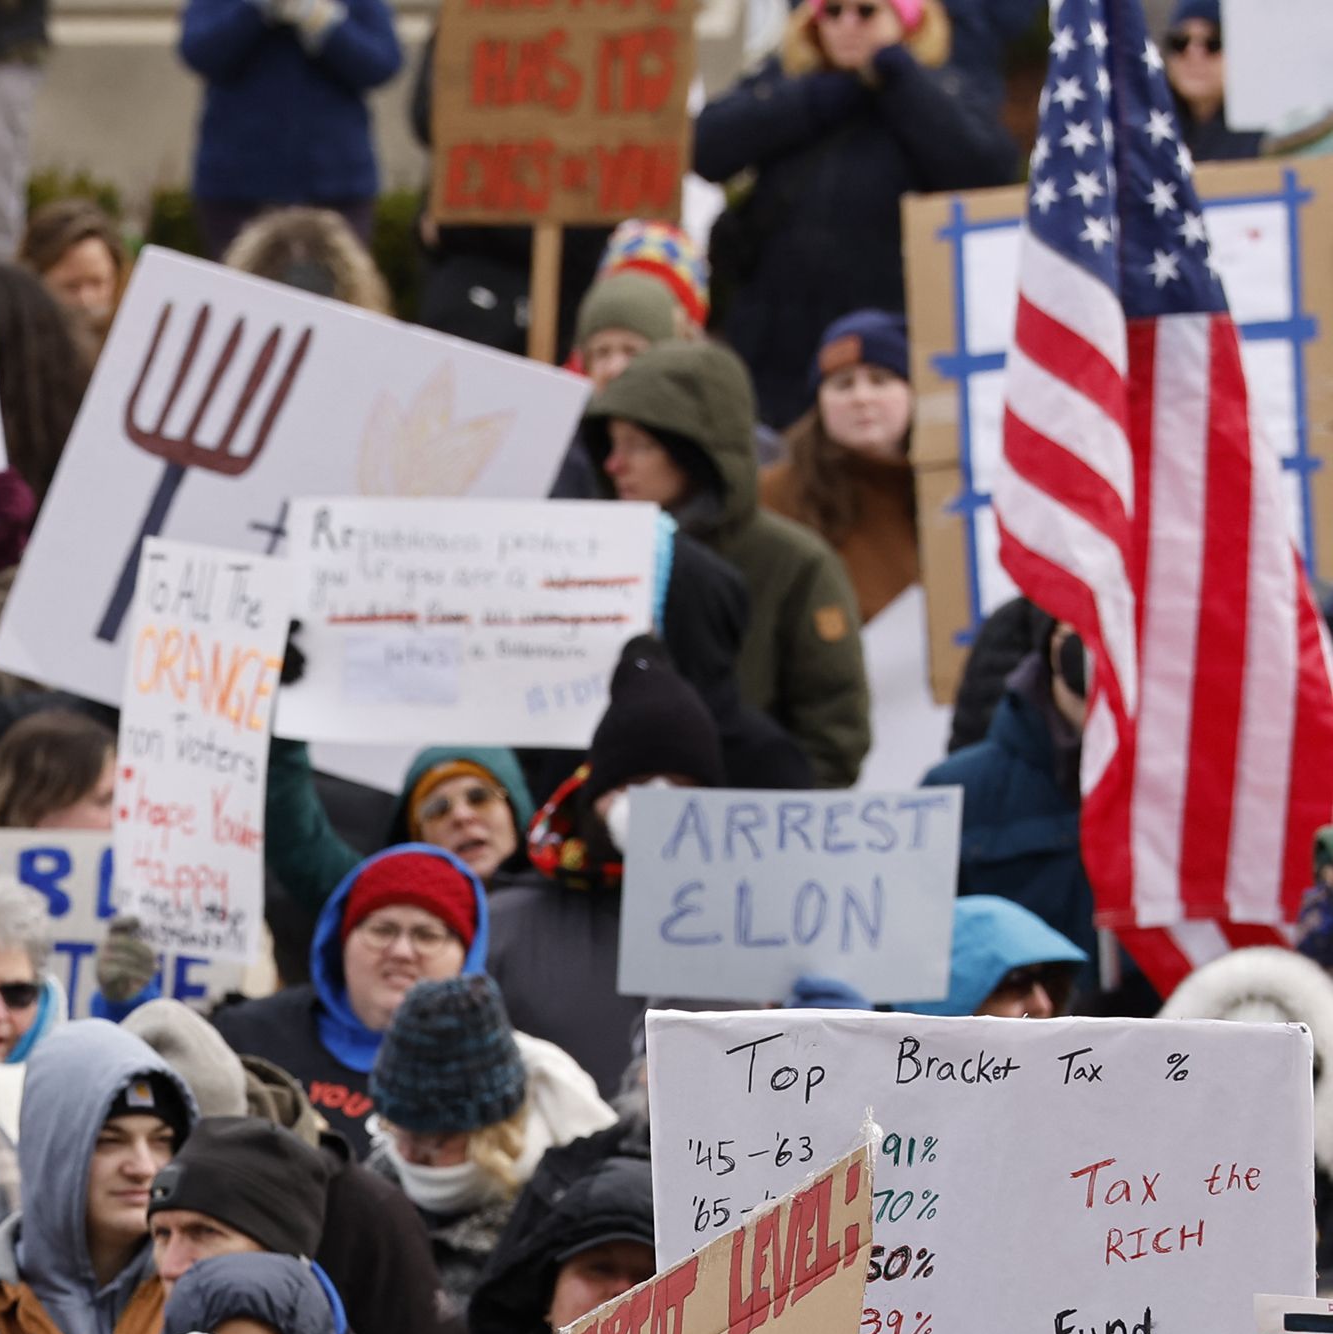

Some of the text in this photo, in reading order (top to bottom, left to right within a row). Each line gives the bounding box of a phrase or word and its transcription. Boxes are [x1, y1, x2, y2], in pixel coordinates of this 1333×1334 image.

[134, 623, 283, 734] ORANGE
[661, 797, 950, 860] ARREST
[659, 874, 886, 954] ELON
[726, 1033, 1190, 1103] Top Bracket Tax %
[882, 1133, 939, 1167] 91%
[1070, 1157, 1261, 1208] Tax the
[1104, 1219, 1205, 1266] RICH
